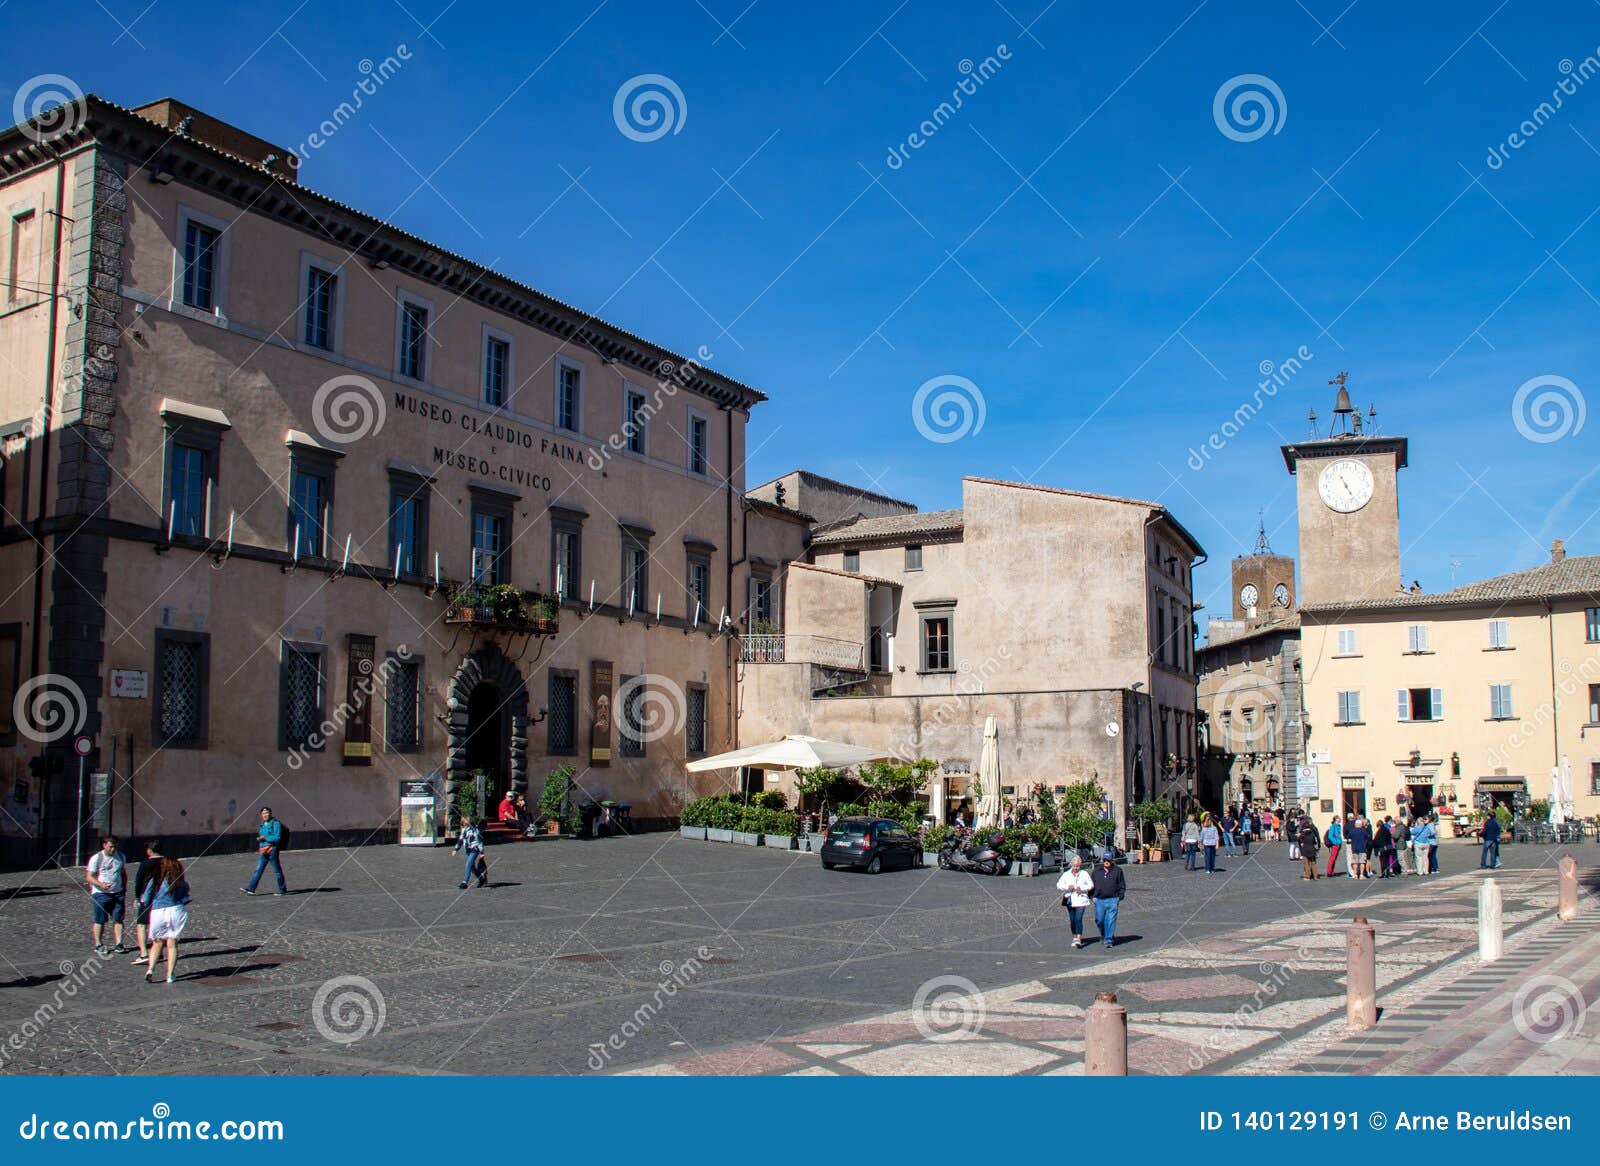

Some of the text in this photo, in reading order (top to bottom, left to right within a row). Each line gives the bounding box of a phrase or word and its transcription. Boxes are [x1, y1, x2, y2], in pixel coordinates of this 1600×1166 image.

[395, 393, 584, 465] MUSEO CLAUDIO FAINA
[433, 446, 551, 492] MUSEO CIVICO
